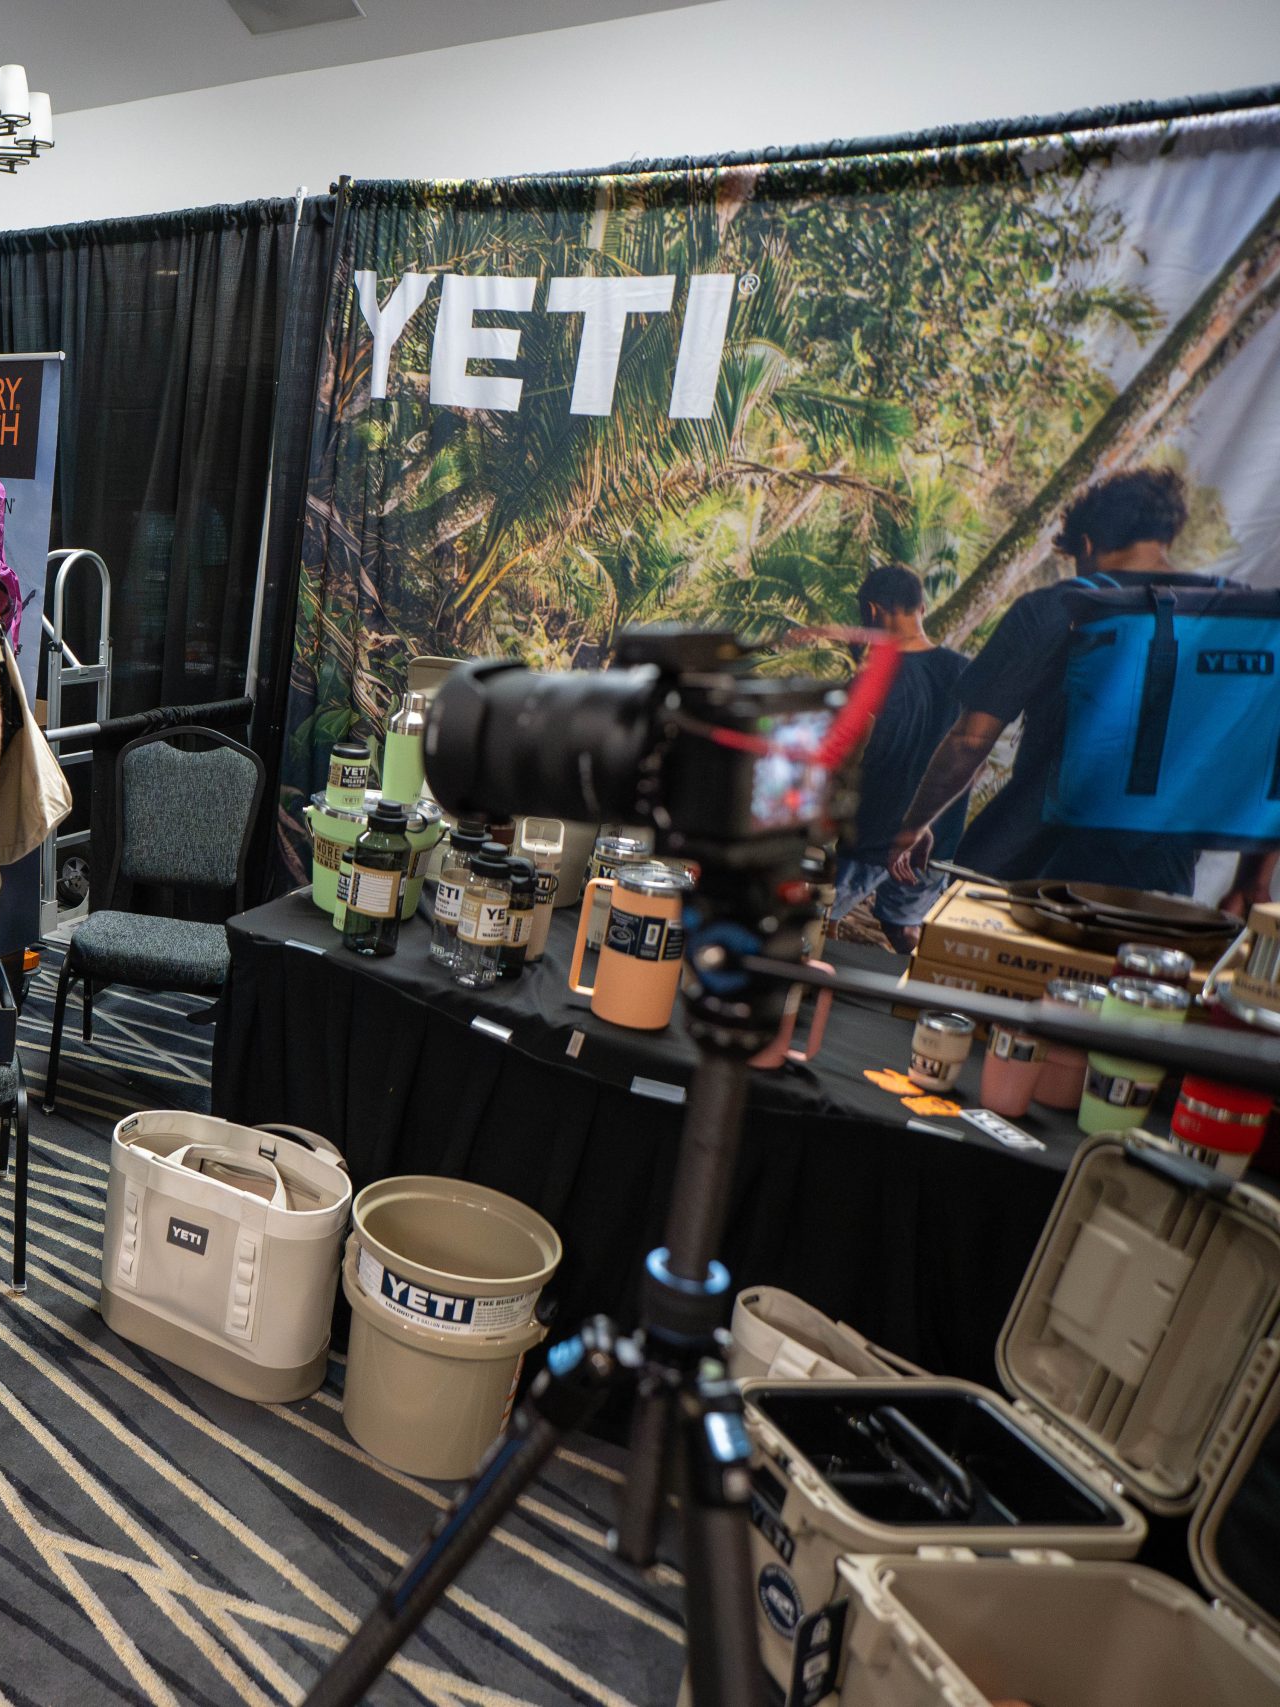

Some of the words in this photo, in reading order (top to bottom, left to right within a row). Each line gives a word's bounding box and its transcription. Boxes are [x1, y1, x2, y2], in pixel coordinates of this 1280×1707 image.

[1205, 654, 1268, 674] YETI
[344, 766, 367, 776] YETI
[438, 883, 460, 901] ETI
[486, 907, 506, 921] YE
[943, 938, 990, 962] YETI
[997, 951, 1054, 973] CAST
[172, 1225, 202, 1246] YETI
[387, 1272, 467, 1321] YETI
